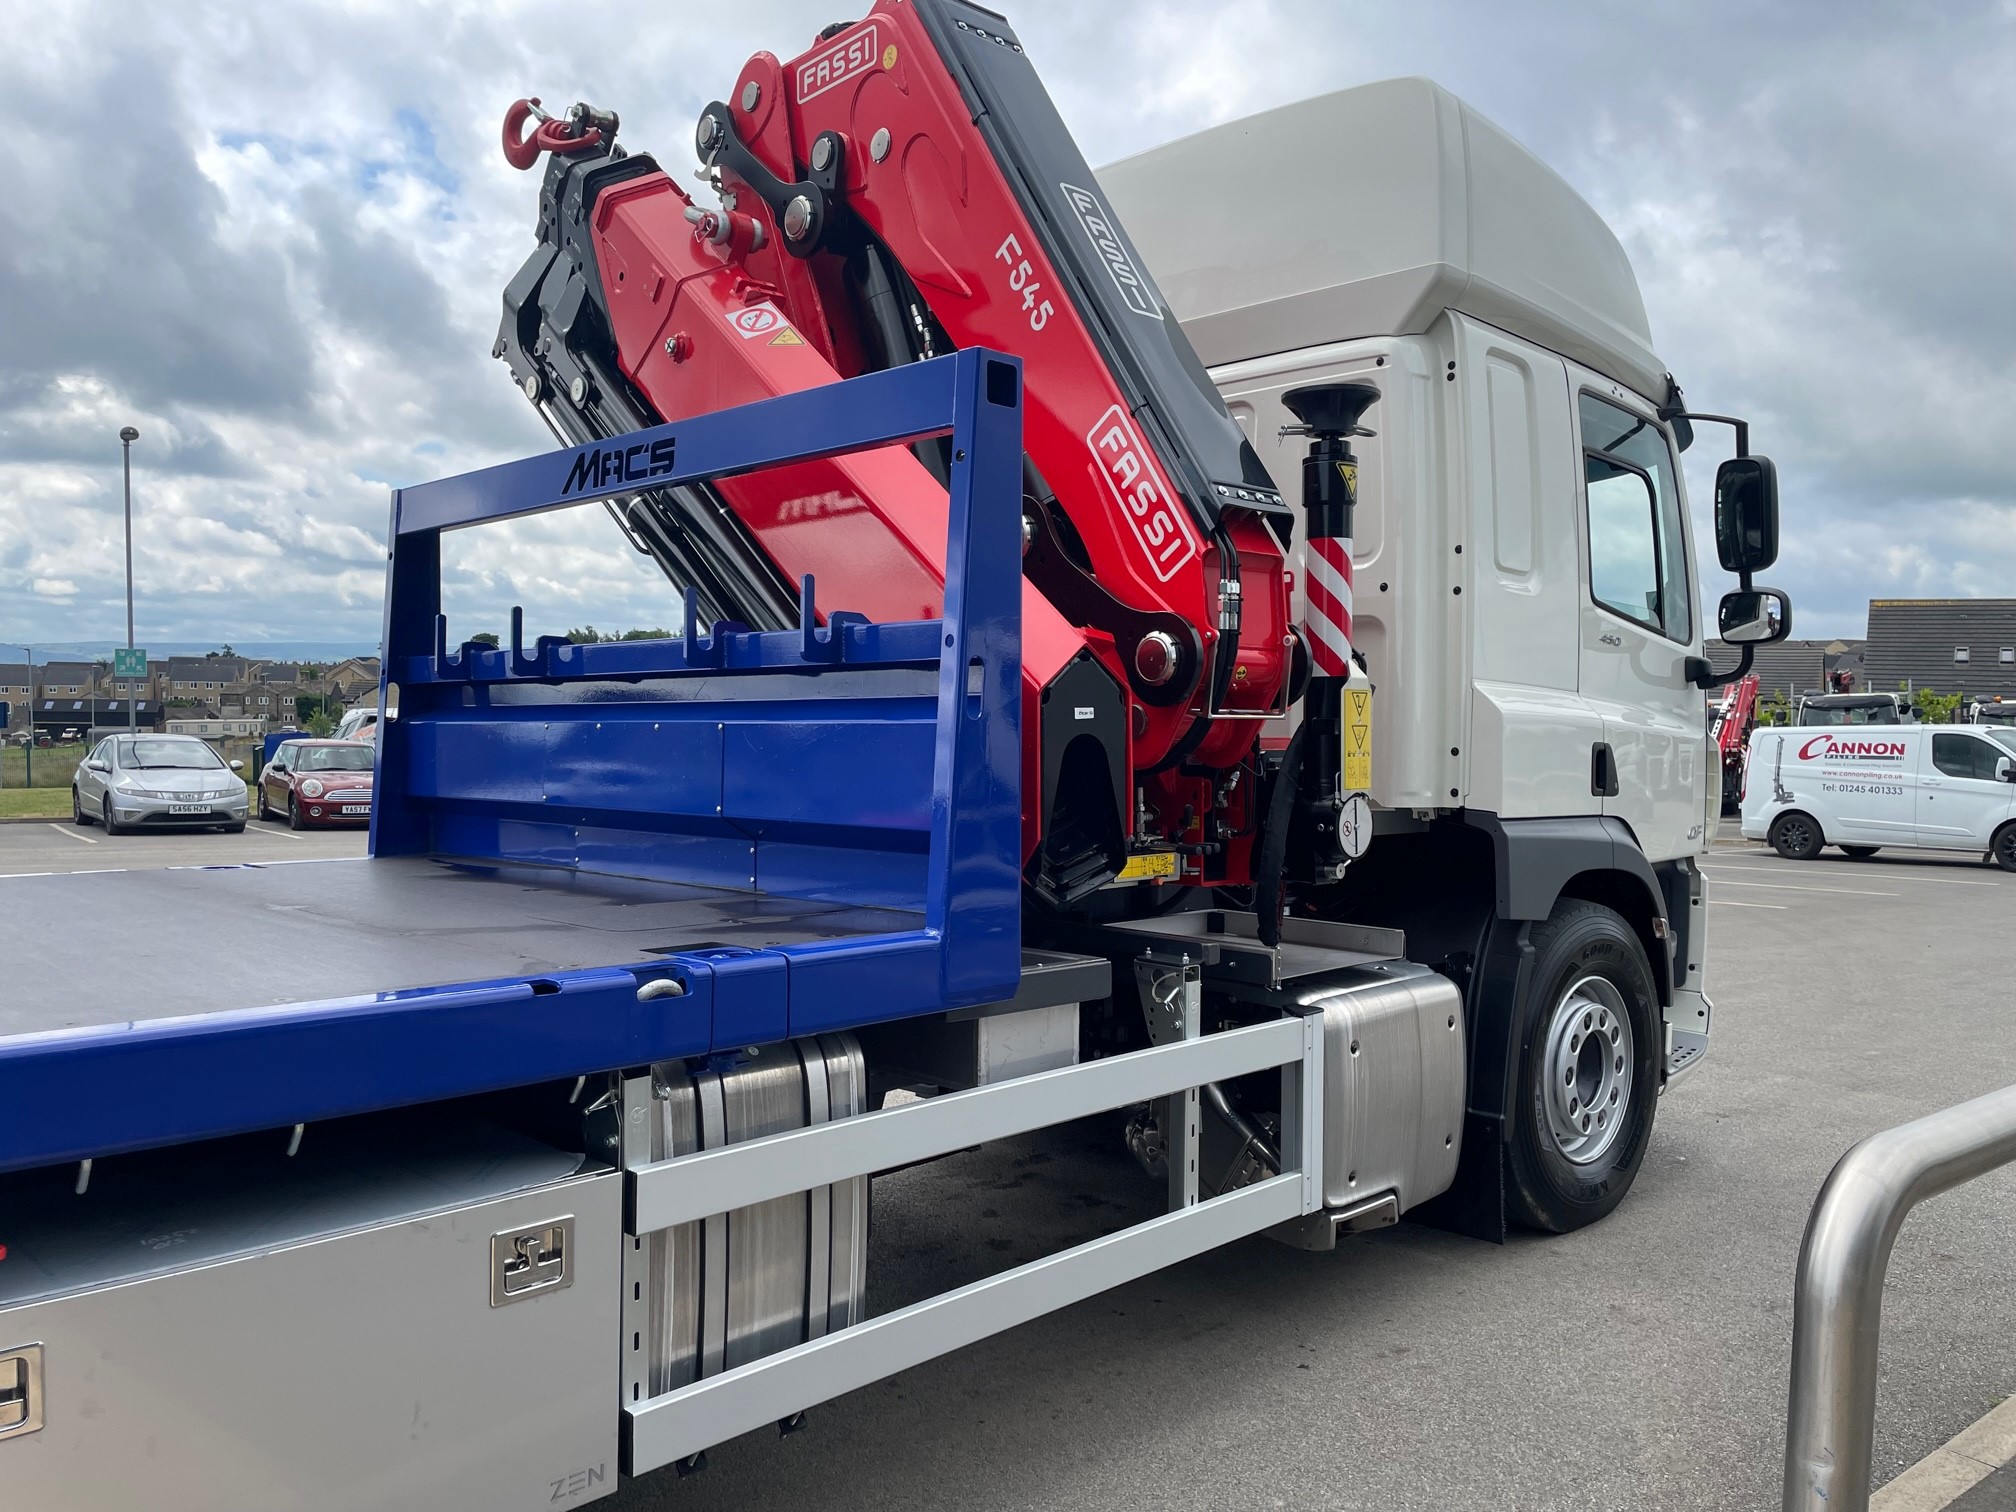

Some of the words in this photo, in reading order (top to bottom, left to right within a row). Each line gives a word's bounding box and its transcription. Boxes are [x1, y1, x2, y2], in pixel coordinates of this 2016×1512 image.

[803, 37, 869, 94] FASSI
[1072, 192, 1146, 309] FASSI
[995, 233, 1054, 331] F545
[1099, 425, 1182, 562] FASSI
[1798, 735, 1905, 760] CANNON
[1822, 770, 1903, 780] www.cannonpiling.co.uk
[1822, 783, 1837, 792] Tel:
[1839, 784, 1866, 793] 01245
[1868, 786, 1903, 795] 401333
[172, 805, 192, 813] SA56
[193, 805, 208, 813] HZY
[550, 1463, 605, 1502] ZEN
